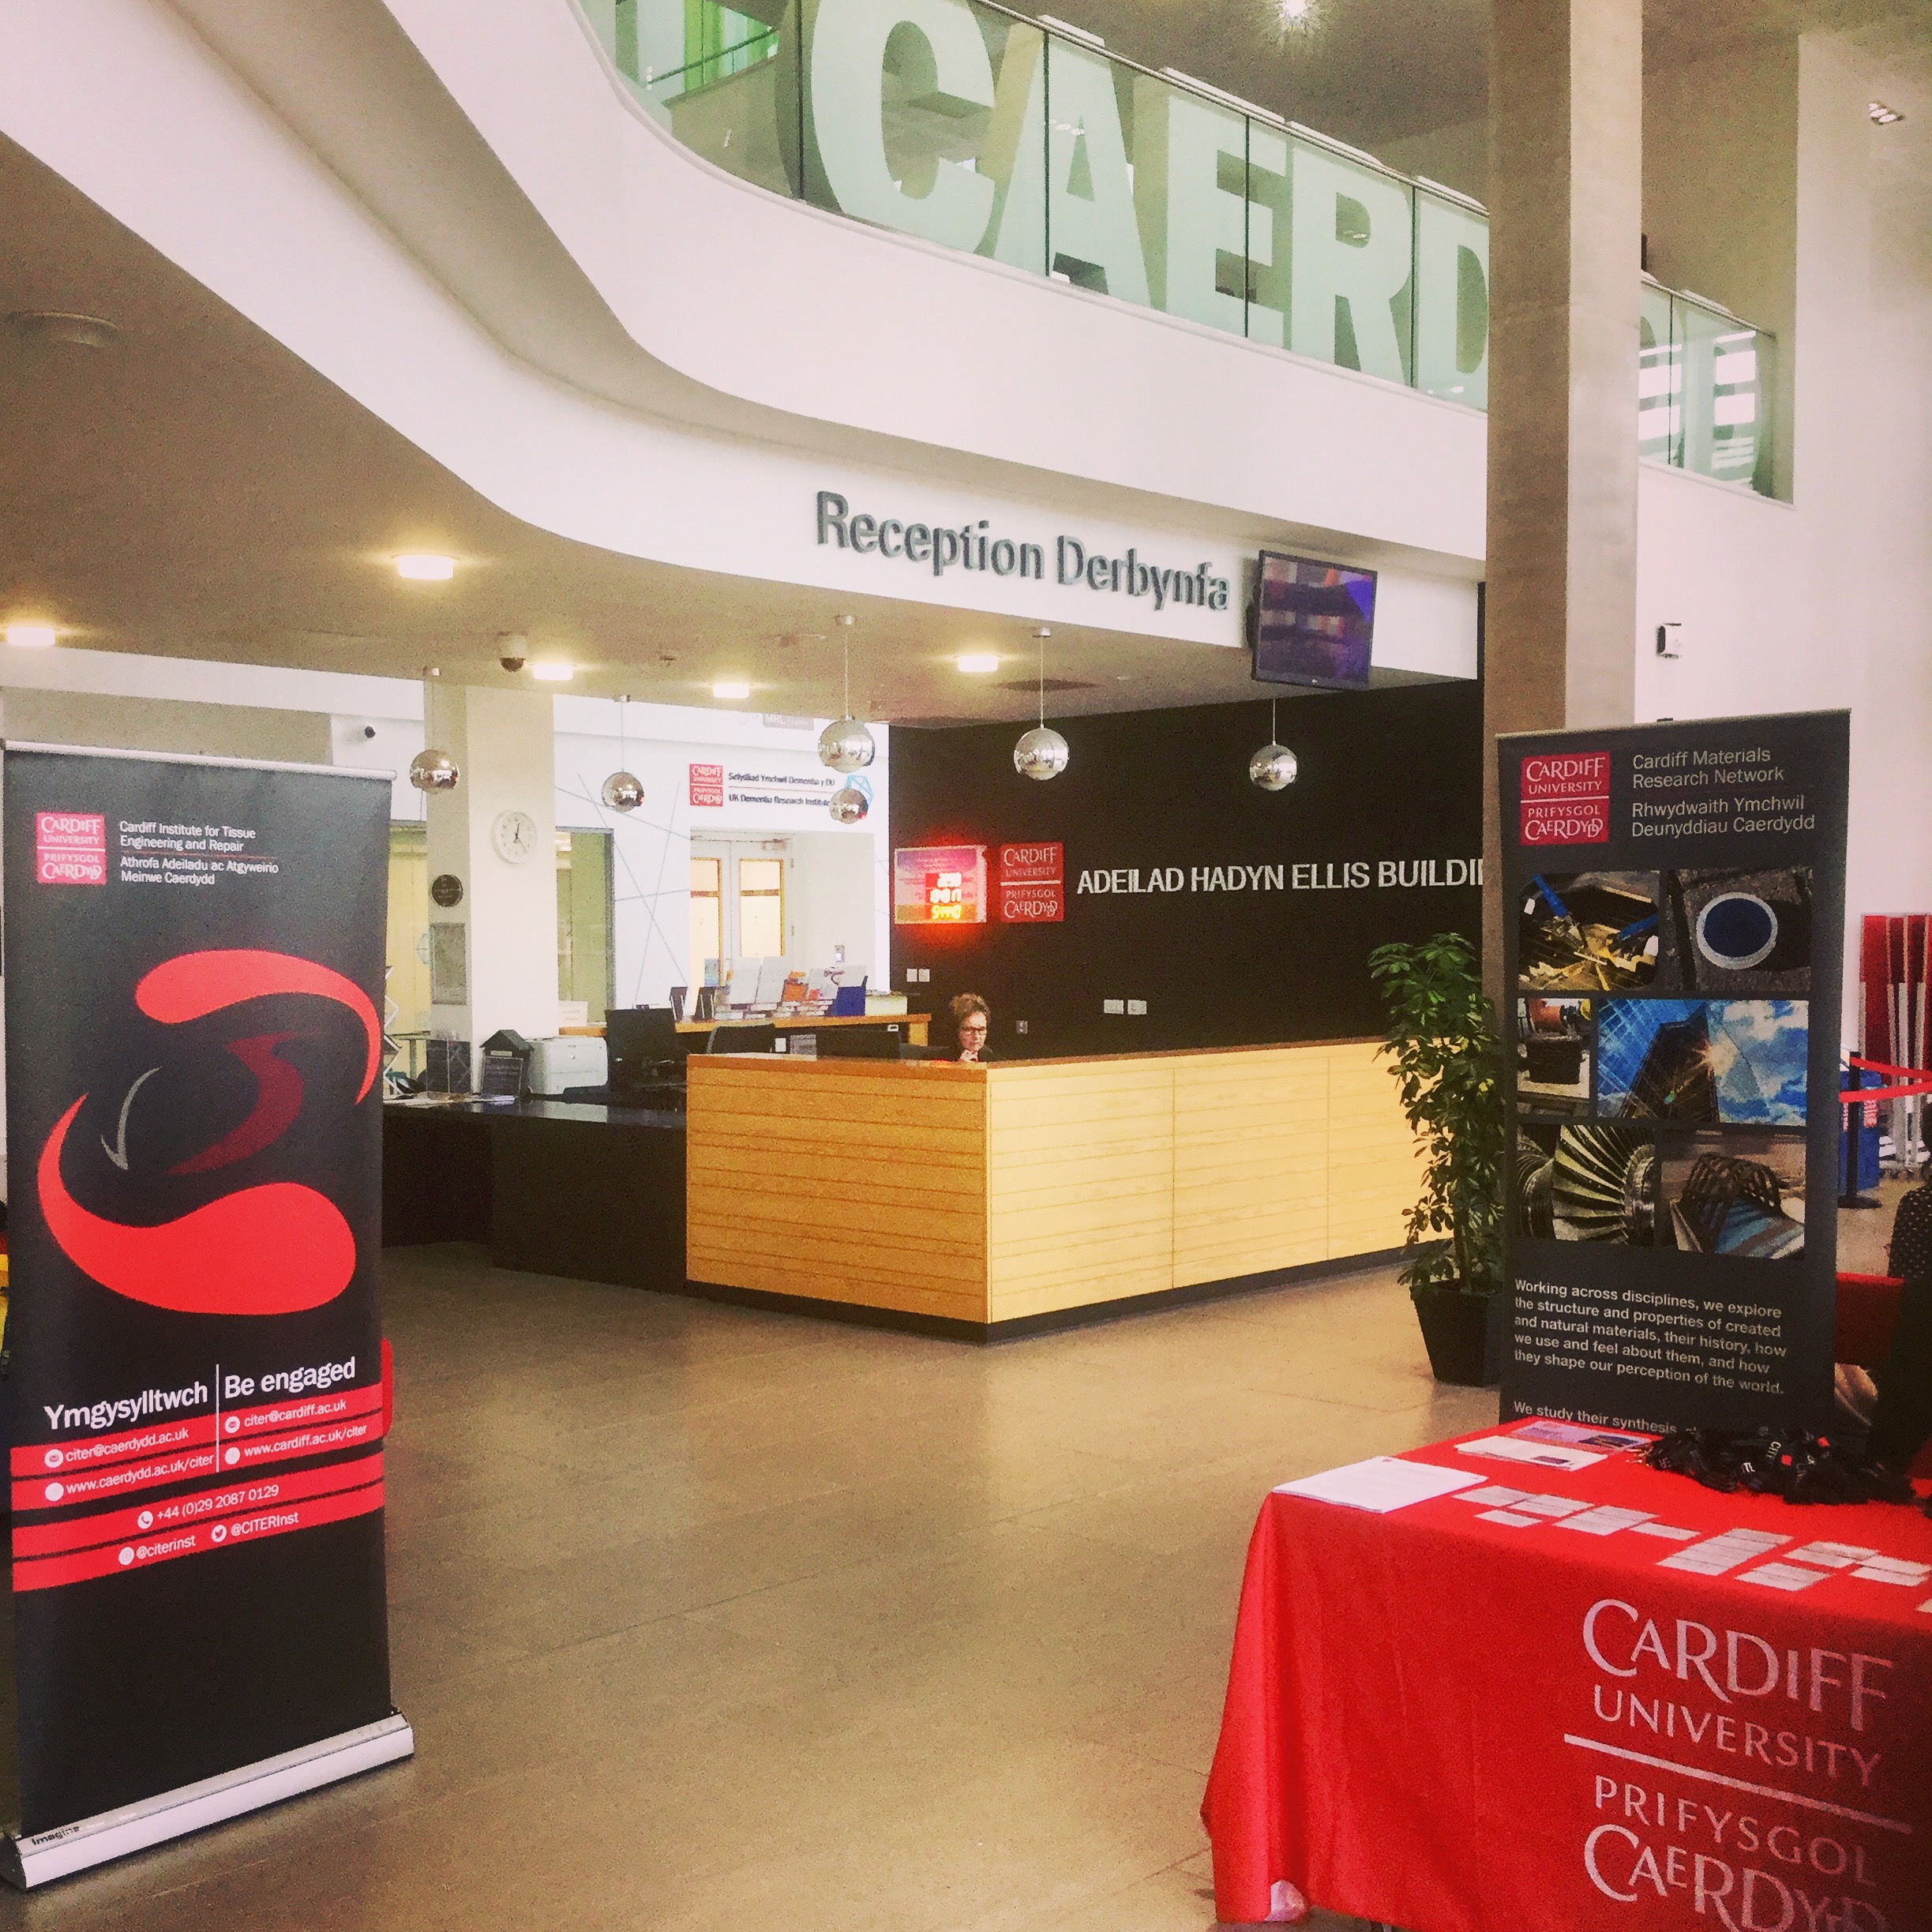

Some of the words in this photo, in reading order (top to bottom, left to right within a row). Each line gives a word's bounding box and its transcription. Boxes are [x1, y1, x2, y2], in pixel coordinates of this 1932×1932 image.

[816, 490, 1045, 576] Reception
[1056, 535, 1229, 611] Derbynfa
[1526, 757, 1605, 782] CARDIFF
[1633, 752, 1688, 769] Cardiff
[1693, 748, 1771, 766] Materials
[1529, 781, 1602, 794] UNIVERSITY
[1633, 771, 1708, 789] Research
[1714, 767, 1784, 784] Network
[1528, 805, 1600, 817] PRIFYSGOL
[1632, 799, 1728, 820] Rhwydwaith
[1735, 794, 1805, 812] Ymchwil
[41, 816, 100, 835] CARDIFF
[120, 820, 156, 834] Cardiff
[159, 823, 202, 836] Institute
[204, 825, 219, 837] for
[222, 826, 256, 839] Tissue
[1632, 820, 1728, 838] Deunyddiau
[1734, 815, 1814, 833] Caerdydd
[43, 835, 99, 845] UNIVERSITY
[120, 835, 182, 851] Engineering
[185, 839, 205, 850] and
[209, 839, 244, 853] Repair
[43, 853, 99, 863] PRIFYSGOL
[120, 857, 159, 868] Athrofa
[162, 858, 208, 871] Adeiladu
[211, 863, 224, 872] ac
[227, 861, 279, 874] Atgyweirio
[1004, 847, 1057, 866] CARDIFF
[122, 871, 162, 883] Meinwe
[165, 872, 215, 887] Caerdydd
[1006, 867, 1056, 877] UNIVERSITY
[1077, 868, 1184, 894] ADEILAD
[1191, 865, 1284, 892] HADYN
[1292, 861, 1370, 888] ELLIS
[1006, 889, 1056, 898] PRIFYSGOL
[1515, 1279, 1567, 1298] Working
[1572, 1286, 1618, 1300] across
[1623, 1290, 1699, 1311] disciplines,
[1703, 1300, 1724, 1312] we
[1728, 1304, 1781, 1318] explore
[1515, 1297, 1533, 1309] the
[1537, 1301, 1599, 1316] structure
[1604, 1308, 1629, 1319] and
[1634, 1311, 1703, 1328] properties
[1708, 1319, 1722, 1330] of
[1726, 1322, 1780, 1337] created
[1514, 1316, 1537, 1328] and
[1541, 1319, 1589, 1333] natural
[1592, 1326, 1660, 1342] materials,
[1664, 1330, 1696, 1345] their
[1700, 1335, 1750, 1355] history,
[1755, 1342, 1787, 1357] how
[1514, 1334, 1532, 1344] we
[1536, 1337, 1559, 1348] use
[1563, 1340, 1589, 1351] and
[1592, 1342, 1618, 1354] feel
[1623, 1345, 1662, 1360] about
[1666, 1349, 1703, 1367] them,
[1709, 1357, 1735, 1369] and
[1739, 1357, 1769, 1374] how
[224, 1375, 254, 1398] Be
[261, 1356, 355, 1393] engaged
[1514, 1349, 1540, 1365] they
[1544, 1354, 1585, 1369] shape
[1589, 1360, 1613, 1371] our
[1617, 1364, 1690, 1383] perception
[1695, 1372, 1709, 1383] of
[1713, 1375, 1735, 1388] the
[1739, 1379, 1784, 1394] world.
[44, 1381, 208, 1430] Ymgysylltwch
[245, 1400, 346, 1427] citer@cardiff.ac.uk
[1514, 1401, 1532, 1414] We
[1536, 1406, 1573, 1420] study
[1577, 1410, 1608, 1424] their
[1612, 1417, 1677, 1434] synthesis
[66, 1427, 189, 1462] citer@caerdydd.ac.uk
[245, 1424, 367, 1457] www.cardiff.ac.uk/citer
[66, 1454, 214, 1494] www.caerdydd.ac.uk/citer
[157, 1503, 179, 1519] +44
[182, 1499, 212, 1517] (0)29
[216, 1491, 245, 1508] 2087
[248, 1484, 279, 1500] 0129
[231, 1512, 298, 1536] @CITERInst
[137, 1535, 196, 1559] @citerinst
[1583, 1599, 1893, 1731] CARDIFF
[1593, 1684, 1881, 1788] UNIVERSITY
[1595, 1775, 1877, 1887] PRIFYSGOL
